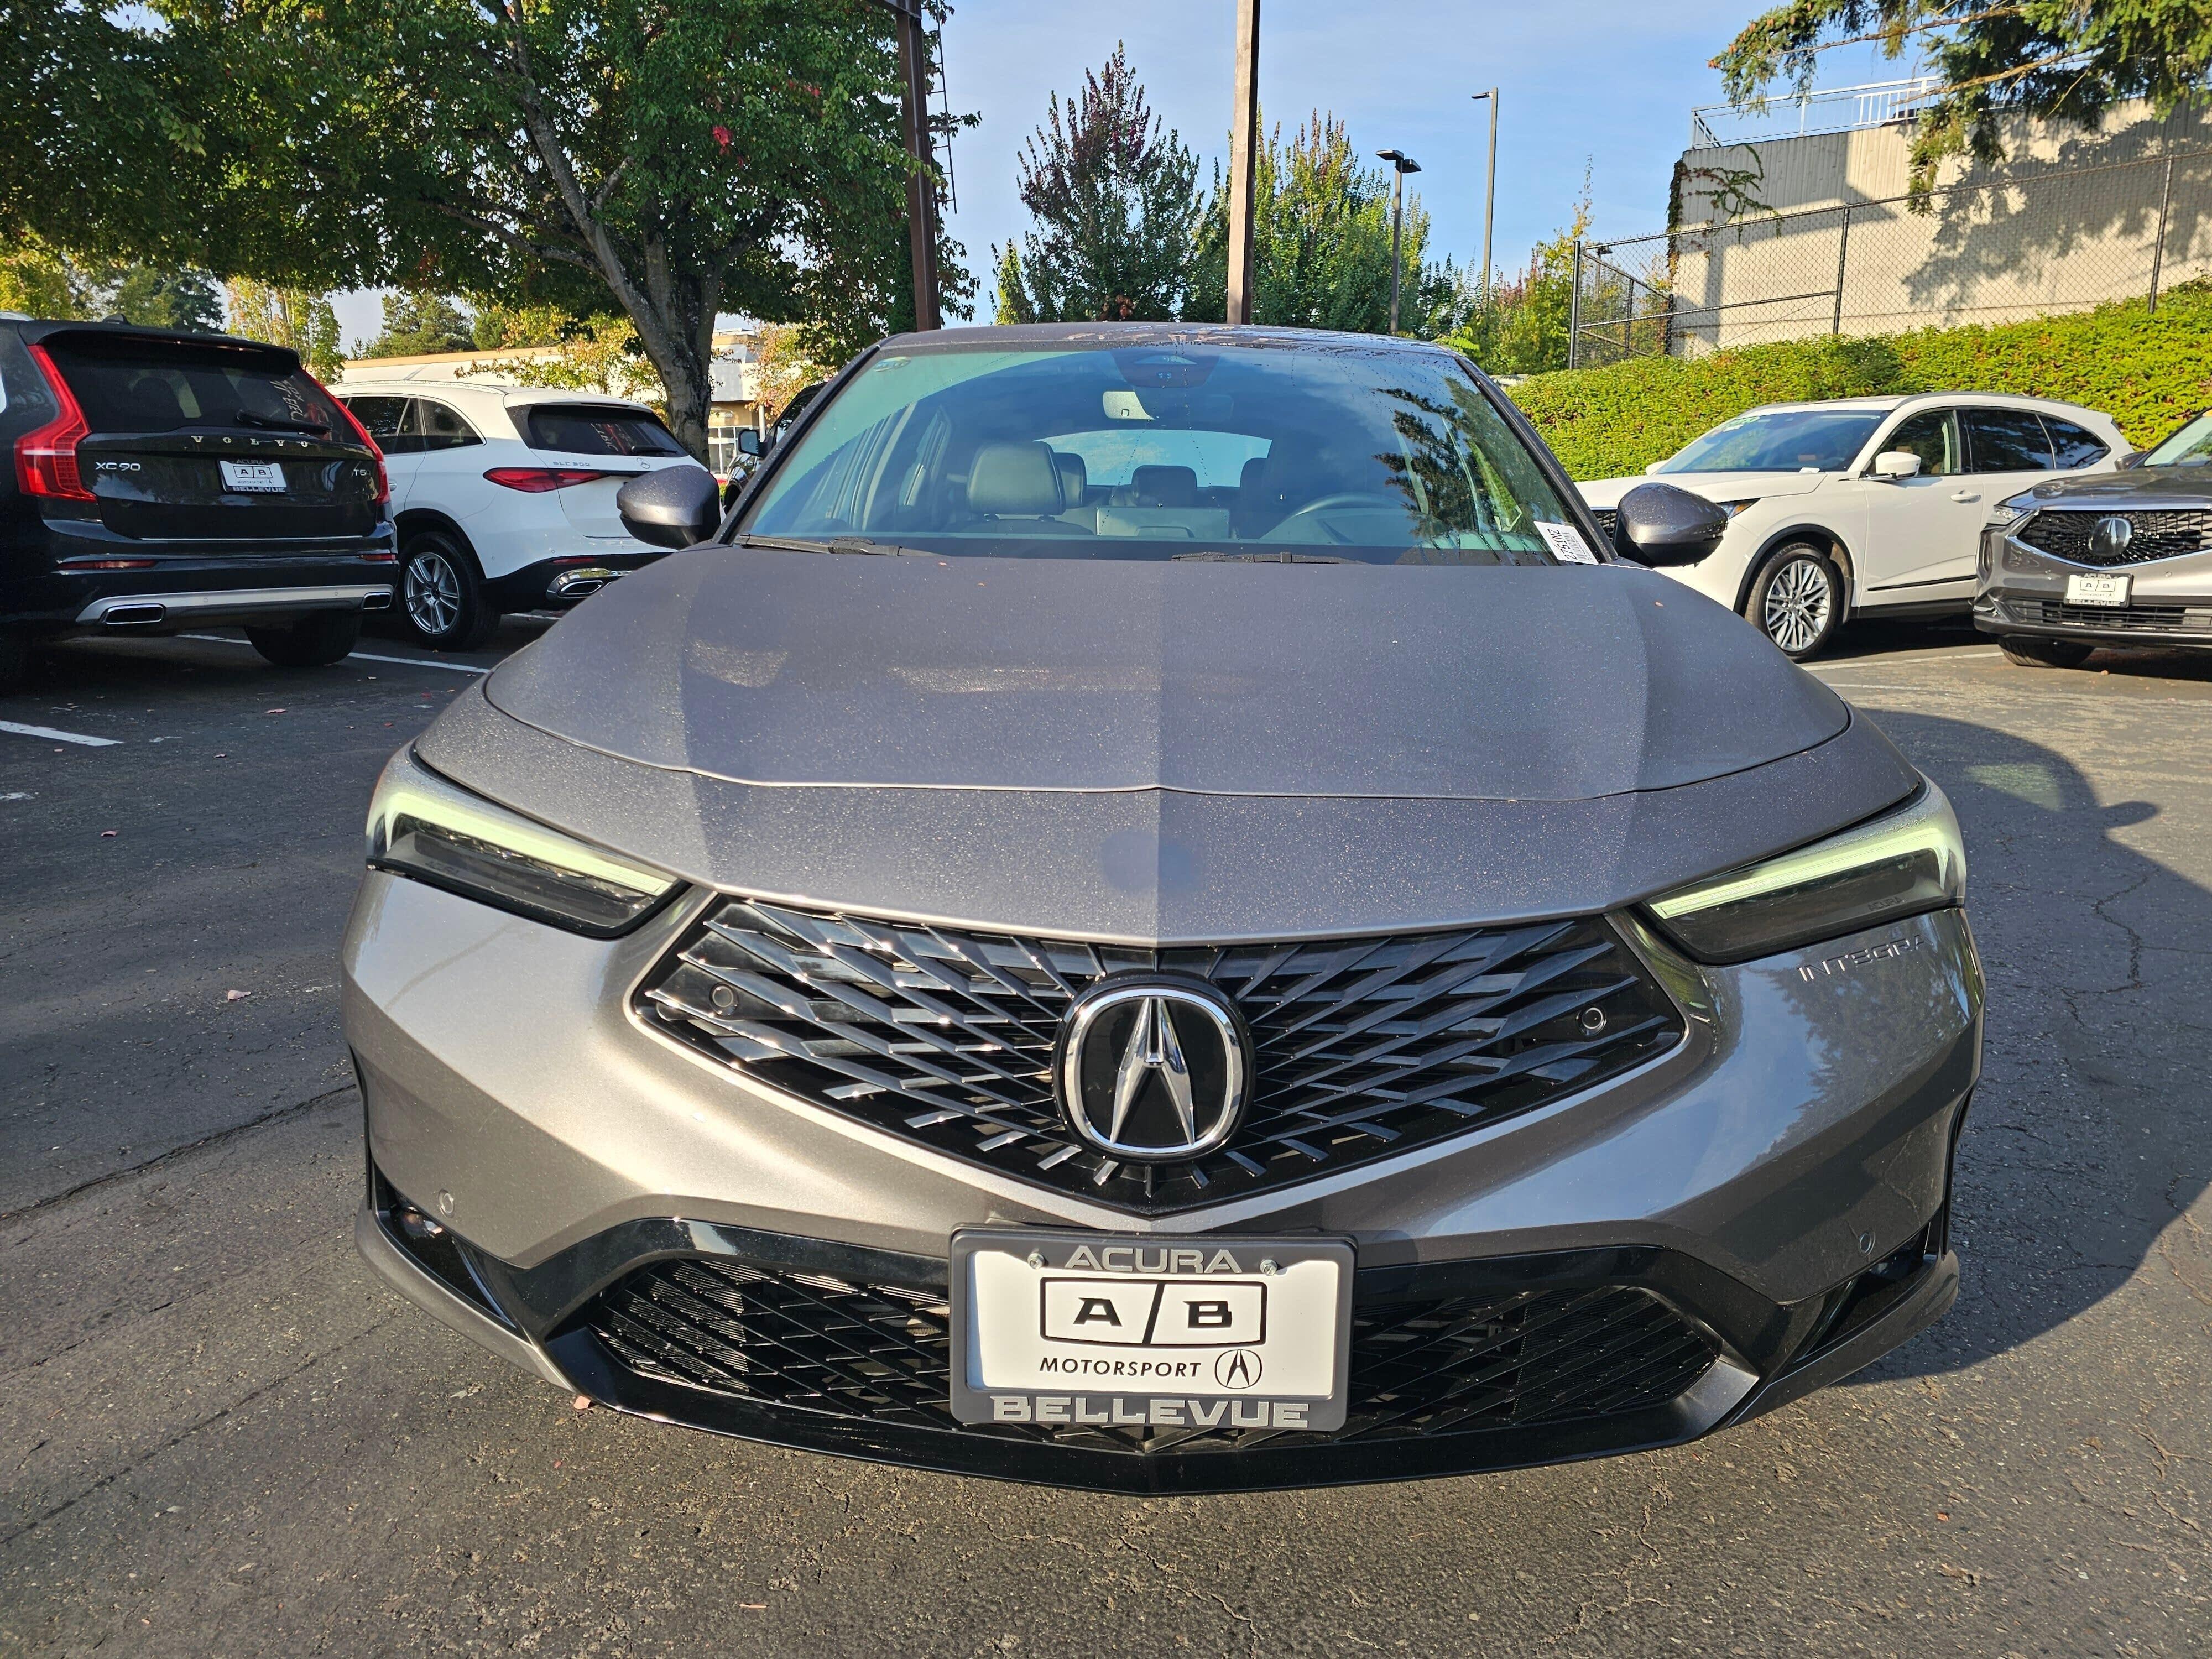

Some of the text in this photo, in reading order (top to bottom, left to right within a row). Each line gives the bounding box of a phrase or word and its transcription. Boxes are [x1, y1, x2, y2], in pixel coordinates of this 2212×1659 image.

[191, 436, 308, 447] VOLVO
[1867, 896, 1903, 911] ACURA
[1797, 935, 1934, 982] INTEGRA
[1065, 1245, 1243, 1274] ACURA
[1073, 1297, 1232, 1328] A B
[1039, 1357, 1201, 1378] MOTORSPORT
[990, 1396, 1309, 1428] BELLEVUE
